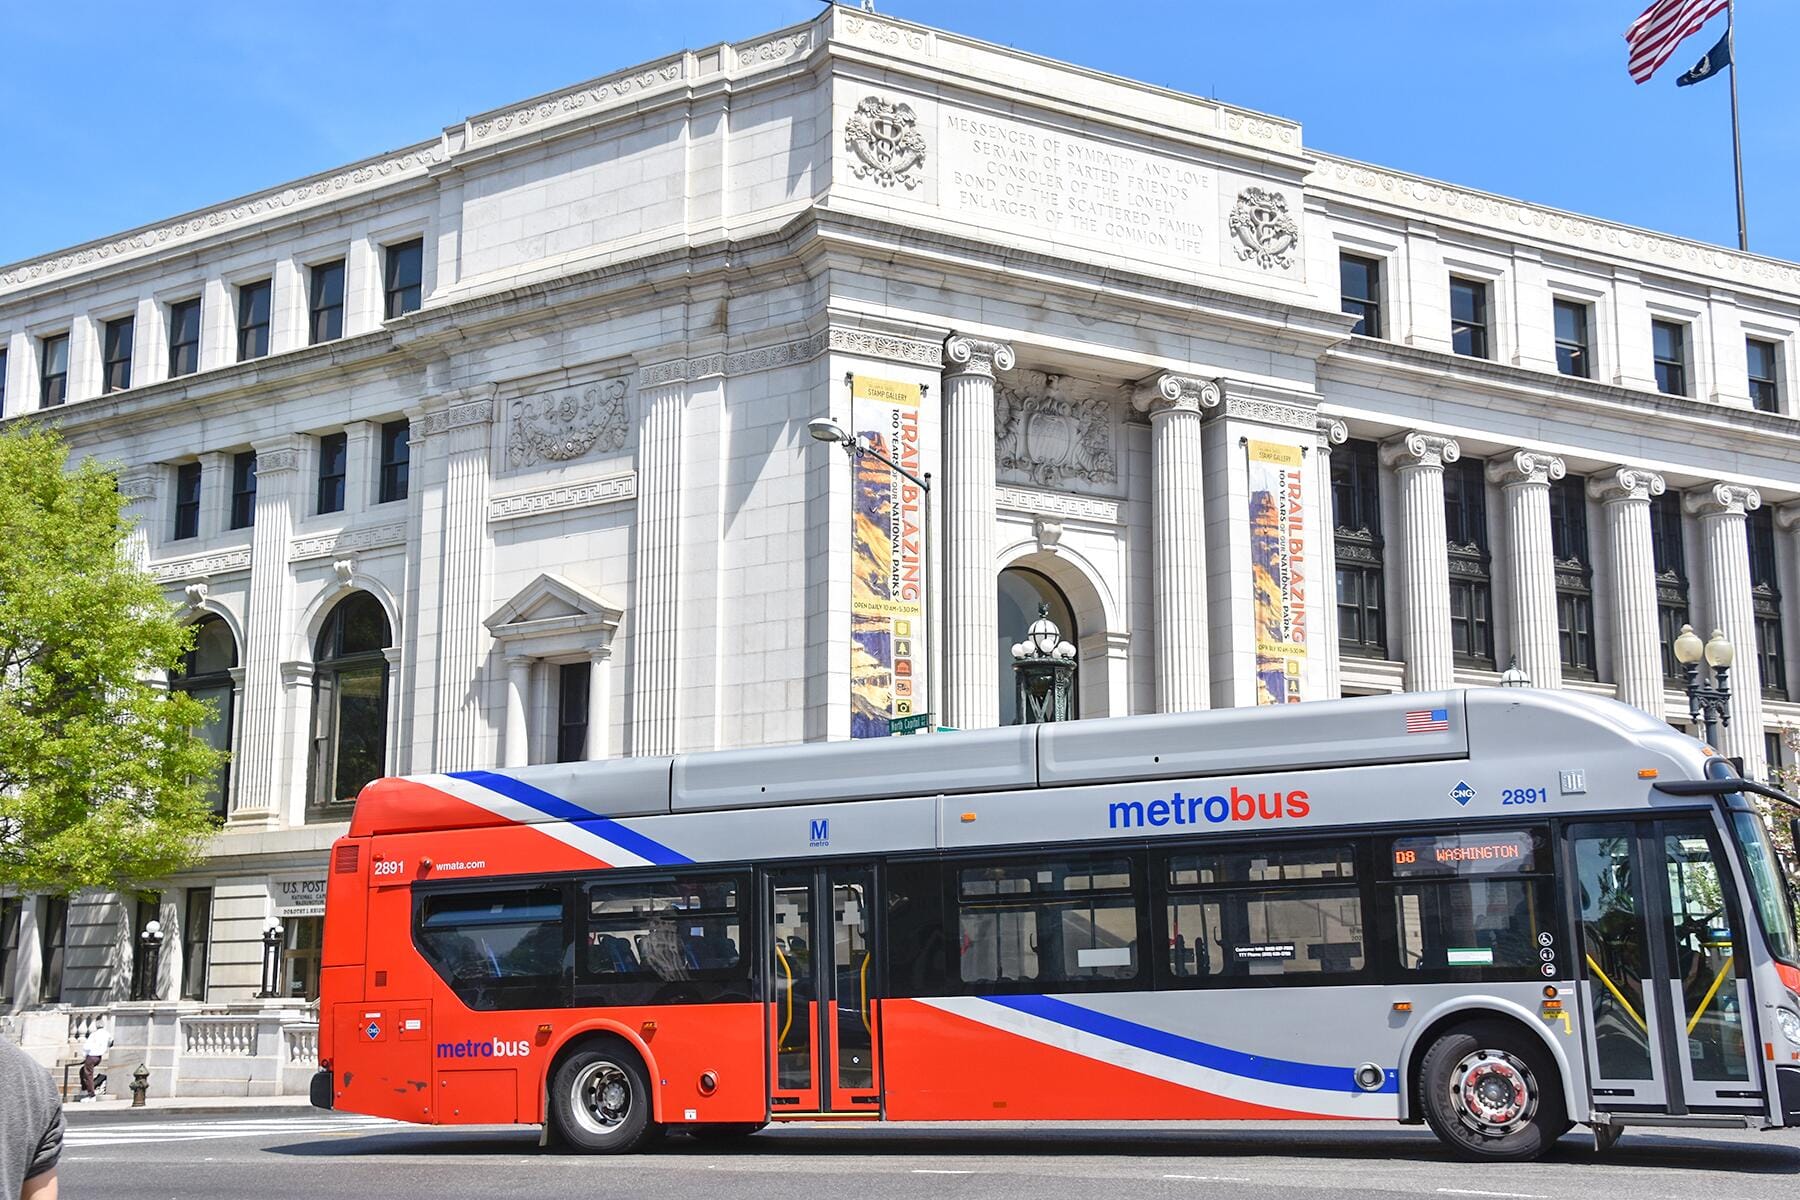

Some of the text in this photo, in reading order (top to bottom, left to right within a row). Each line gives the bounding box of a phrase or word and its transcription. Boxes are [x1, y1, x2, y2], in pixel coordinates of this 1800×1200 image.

[947, 115, 1209, 189] MESSENGER OF SYMPATHY AND LOVE
[972, 140, 1189, 201] SERVANT OF PARTED FRIENDS
[986, 161, 1176, 215] CONSOLER OF THE LONELY
[954, 171, 1205, 239] BOND OF THE SCATTERED FAMILY
[960, 190, 1202, 255] ENLARGER OF THE COMMON LIFE
[885, 391, 907, 402] GALLERY
[891, 408, 899, 429] 100
[891, 431, 899, 467] YEARS
[901, 410, 919, 601] TRAILBLAZING
[1279, 490, 1287, 522] YEARS
[891, 502, 900, 556] NATIONAL
[1288, 470, 1306, 643] TRAILBLAZING
[891, 559, 900, 597] PARKS
[1281, 554, 1289, 601] NATIONAL
[1282, 605, 1290, 640] PARKS
[1109, 786, 1311, 829] metrobus
[1451, 789, 1473, 799] CNG
[1501, 787, 1548, 805] 2891
[811, 820, 827, 839] M
[374, 860, 405, 875] 2891
[436, 860, 486, 871] wmata.com
[1395, 845, 1519, 864] D8 WASHINGTON
[282, 880, 326, 894] U.S. POST
[436, 1036, 531, 1058] metrobus
